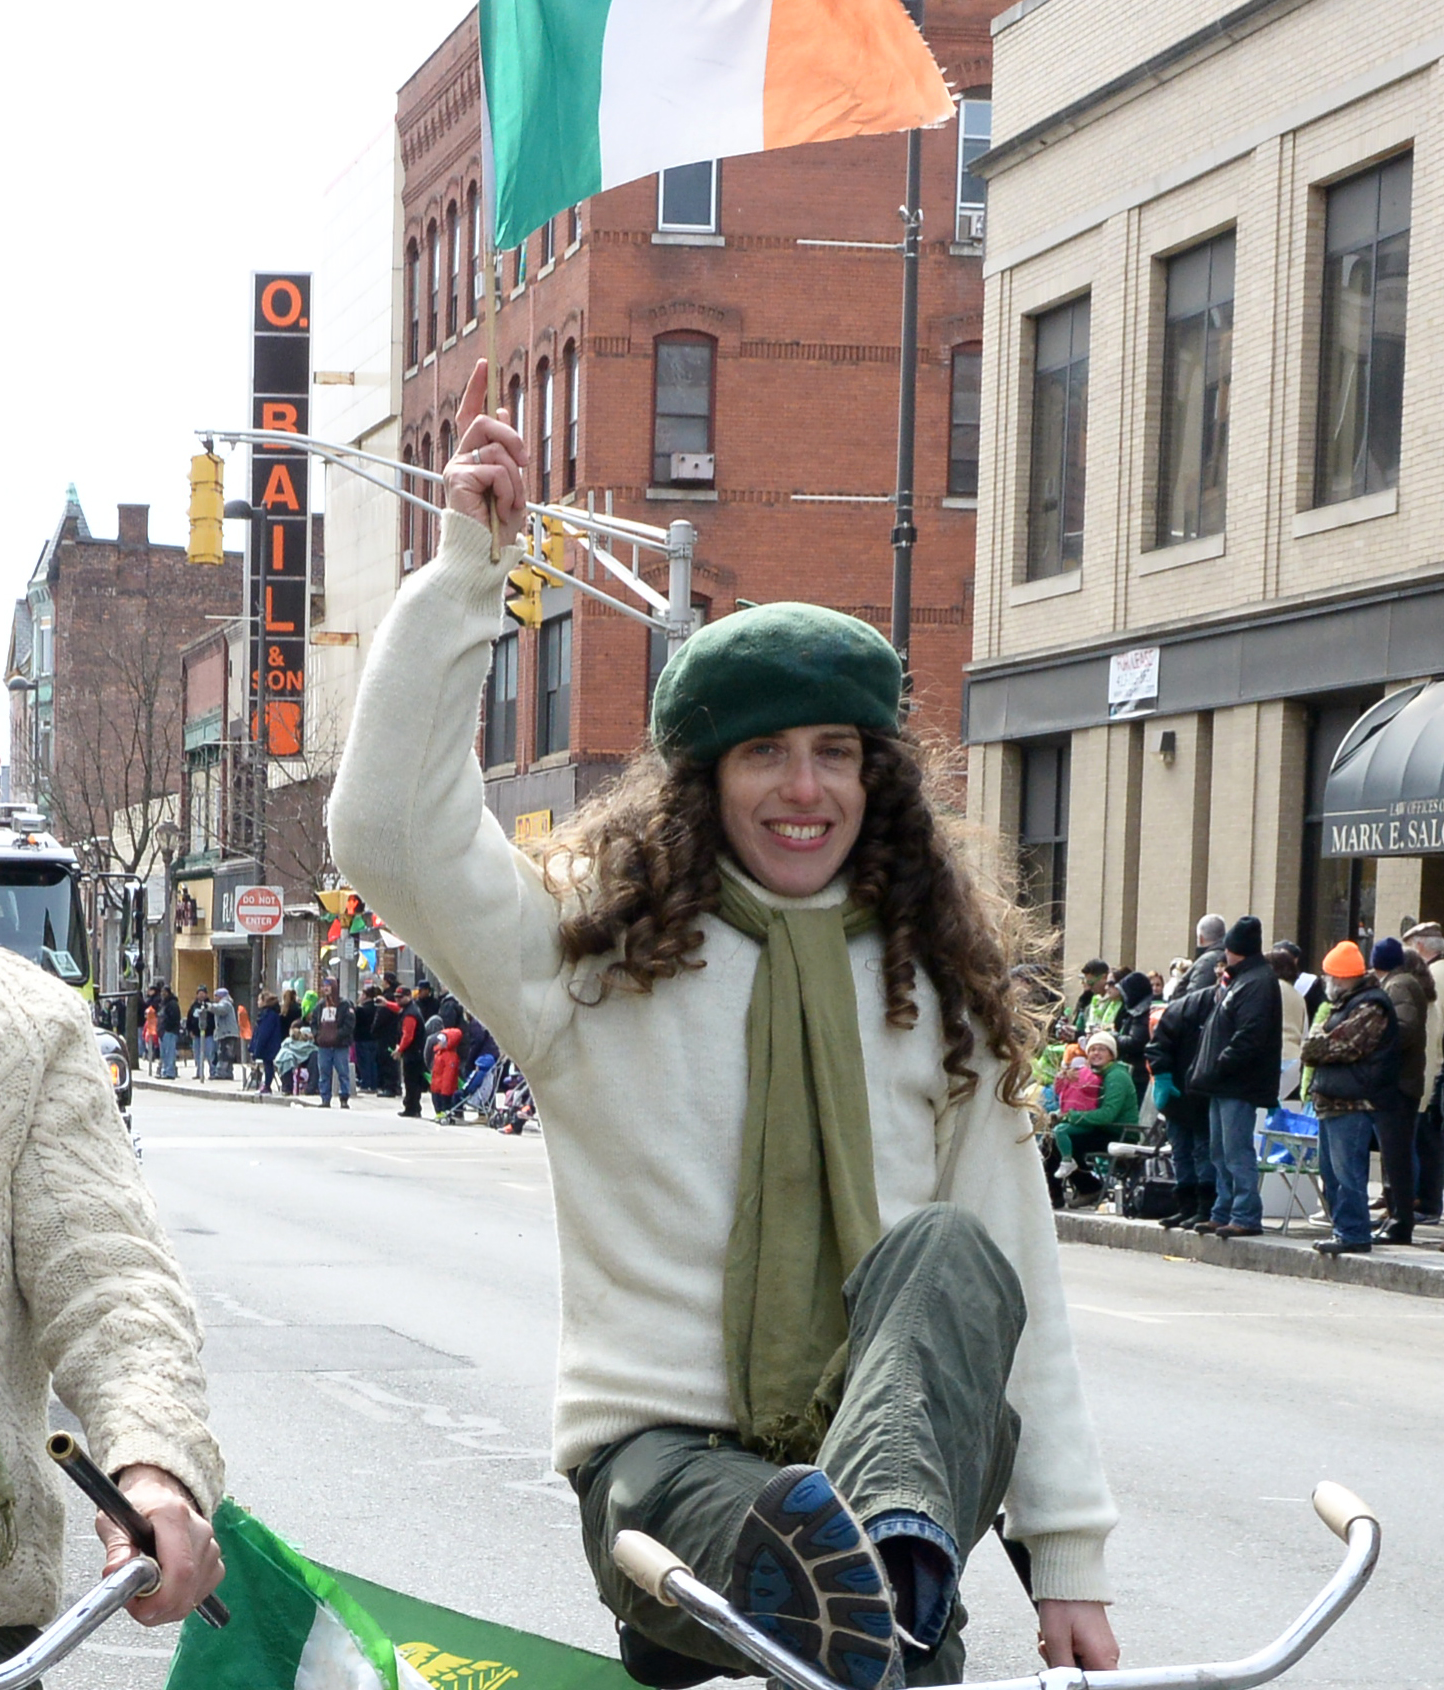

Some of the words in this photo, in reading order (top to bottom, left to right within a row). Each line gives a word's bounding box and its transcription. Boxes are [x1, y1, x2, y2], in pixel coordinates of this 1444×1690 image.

[252, 669, 304, 691] SON
[1389, 801, 1404, 816] LAW
[1407, 799, 1439, 815] OFFICES
[1331, 822, 1384, 853] MARK
[1389, 821, 1405, 850] E.
[242, 895, 255, 905] DO
[258, 895, 276, 905] NOT
[245, 917, 273, 926] ENTER
